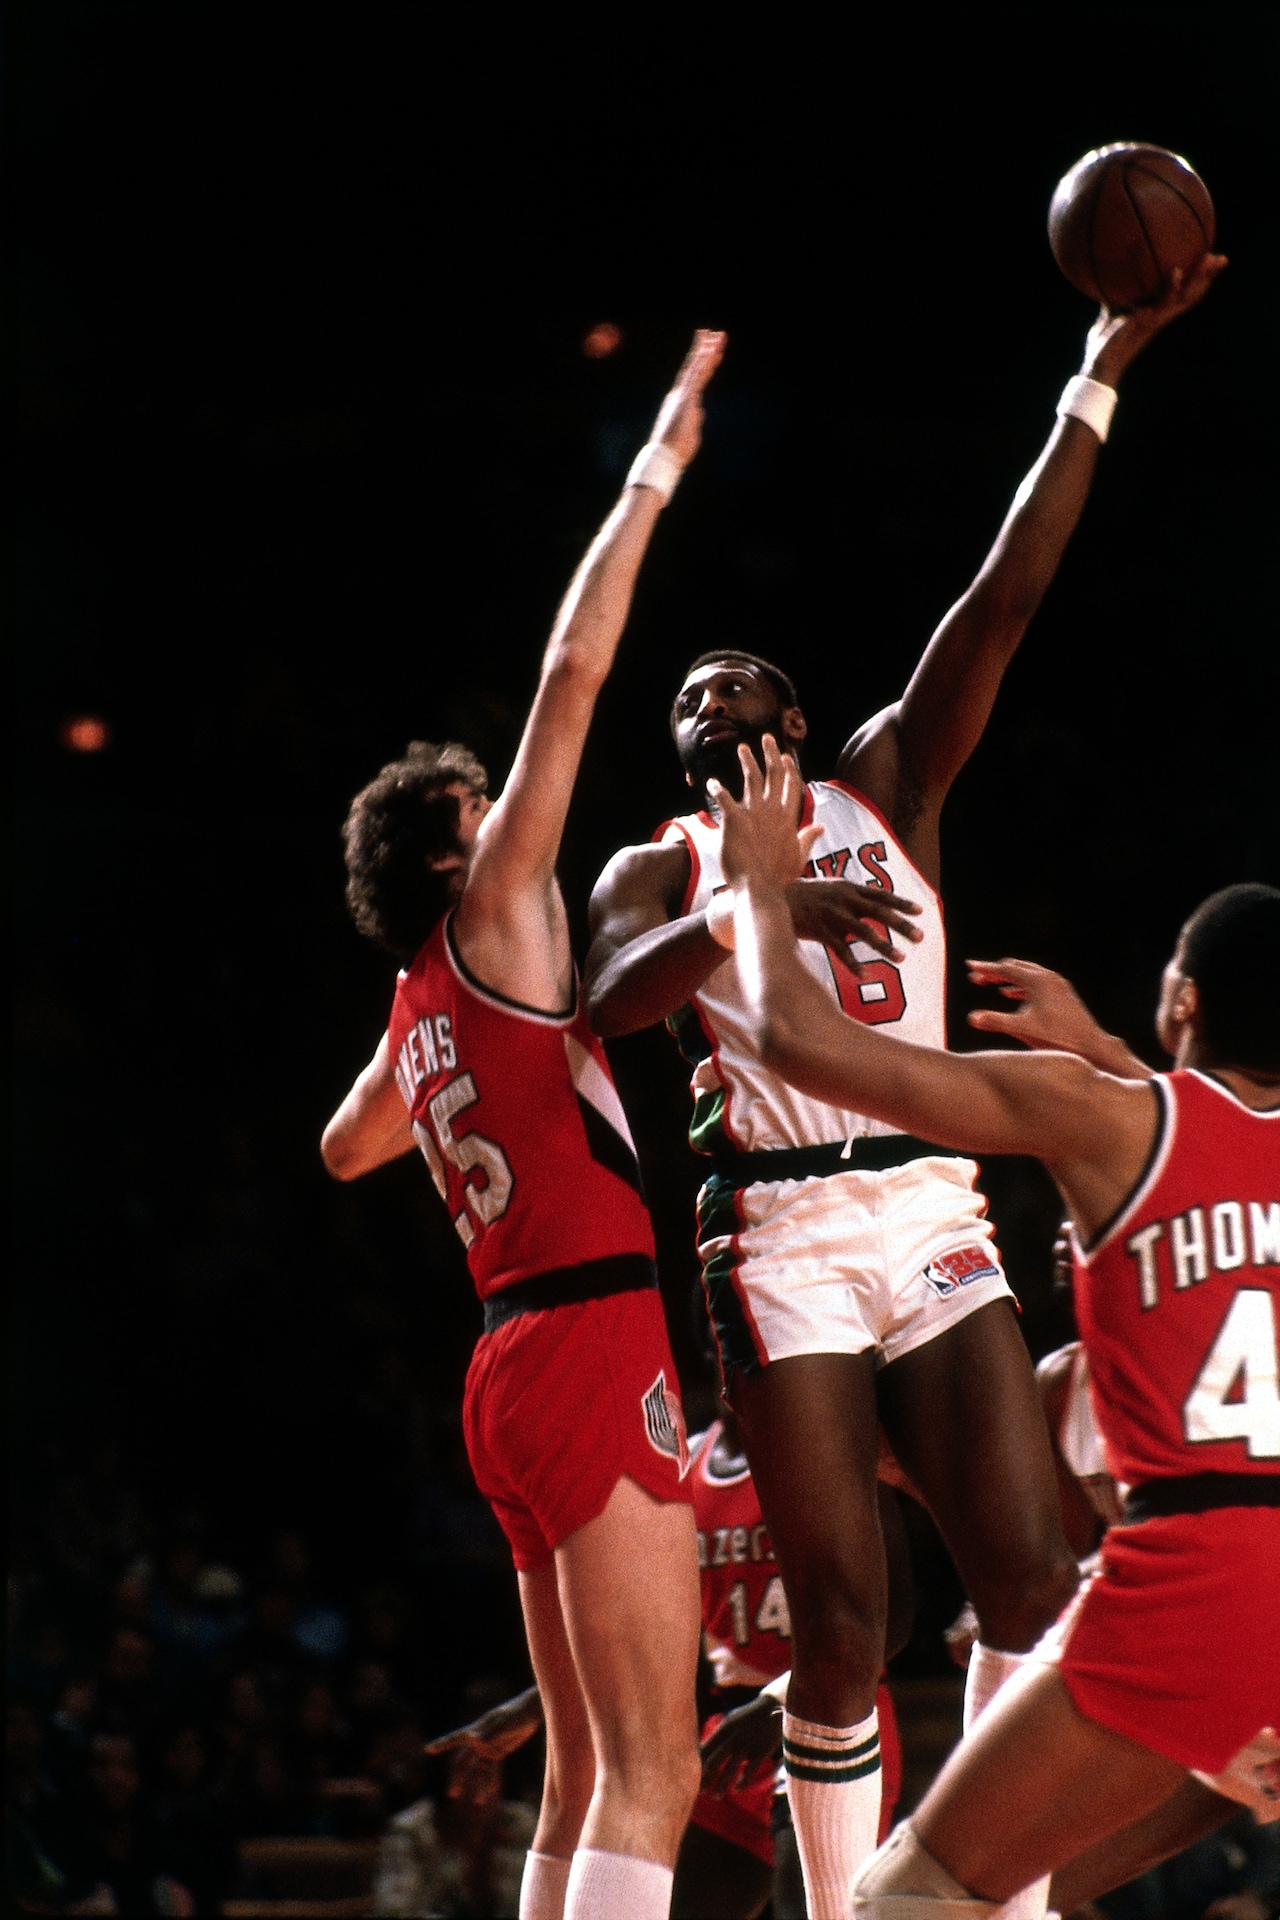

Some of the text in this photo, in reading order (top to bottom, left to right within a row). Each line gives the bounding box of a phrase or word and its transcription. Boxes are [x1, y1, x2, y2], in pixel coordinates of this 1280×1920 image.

[824, 916, 907, 1026] 6
[1183, 1287, 1280, 1461] 4
[729, 1575, 792, 1645] 14
